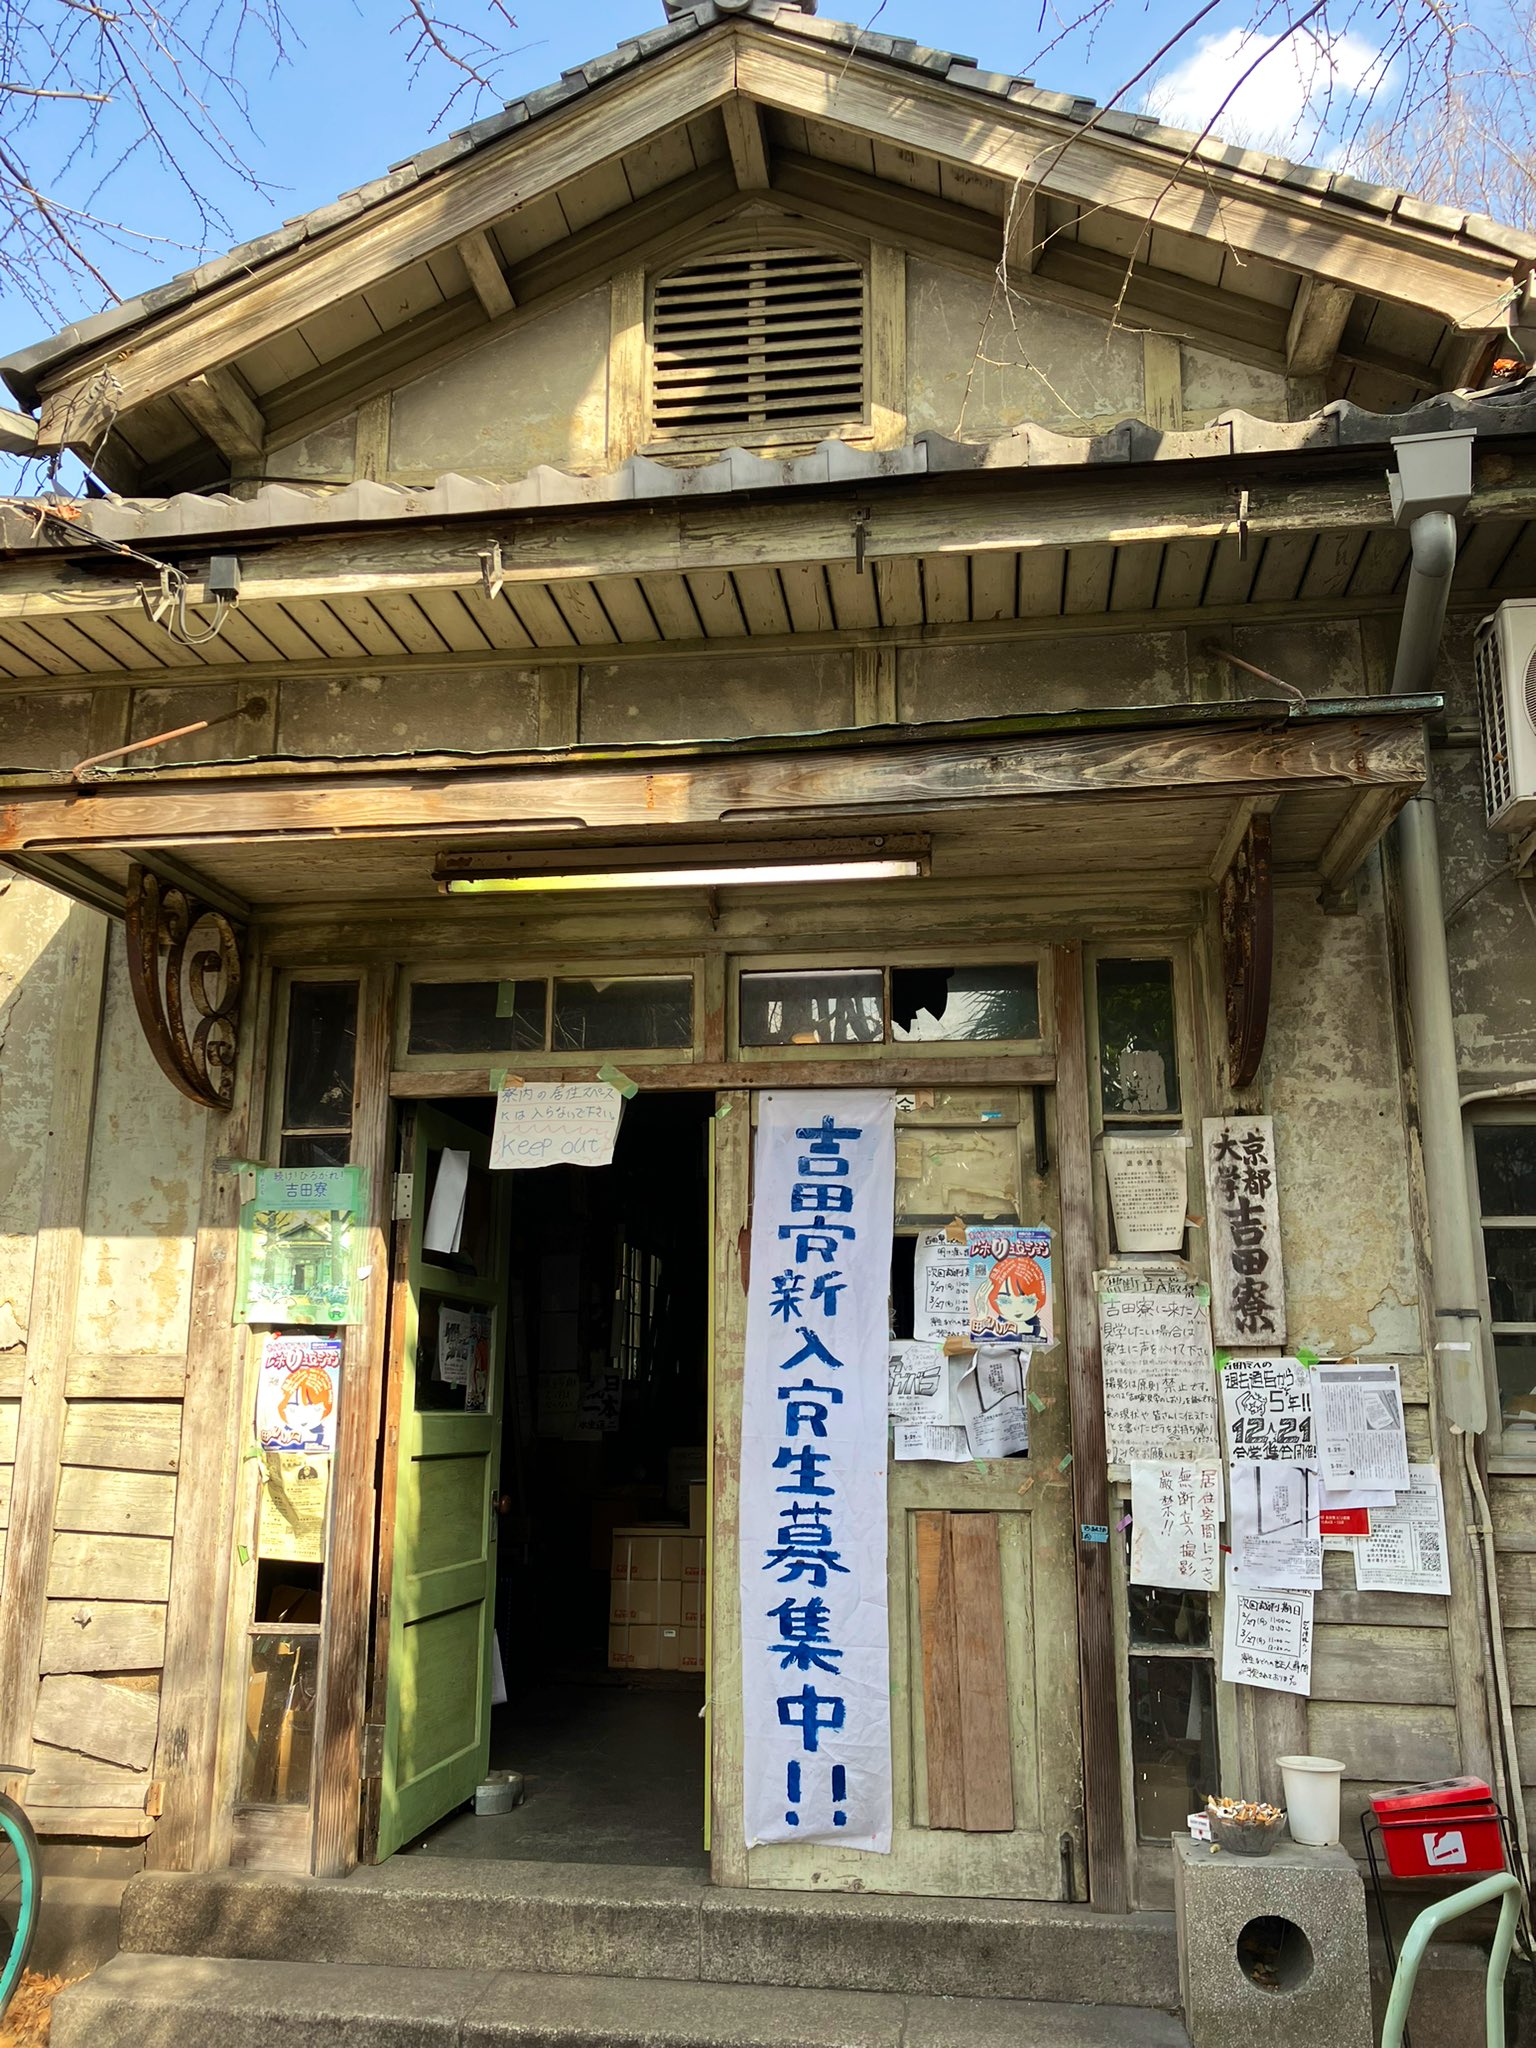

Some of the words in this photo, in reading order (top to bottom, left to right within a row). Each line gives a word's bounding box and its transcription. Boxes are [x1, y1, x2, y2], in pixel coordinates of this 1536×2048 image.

[561, 1138, 600, 1155] out
[286, 1182, 327, 1198] 吉田寮
[1224, 1196, 1277, 1334] 吉田寮
[1104, 1297, 1206, 1320] 吉田寮に来た人
[1103, 1321, 1196, 1339] 見学したい場合は
[1159, 1469, 1175, 1537] 厳禁!!
[1198, 1469, 1218, 1586] 居住空間につき
